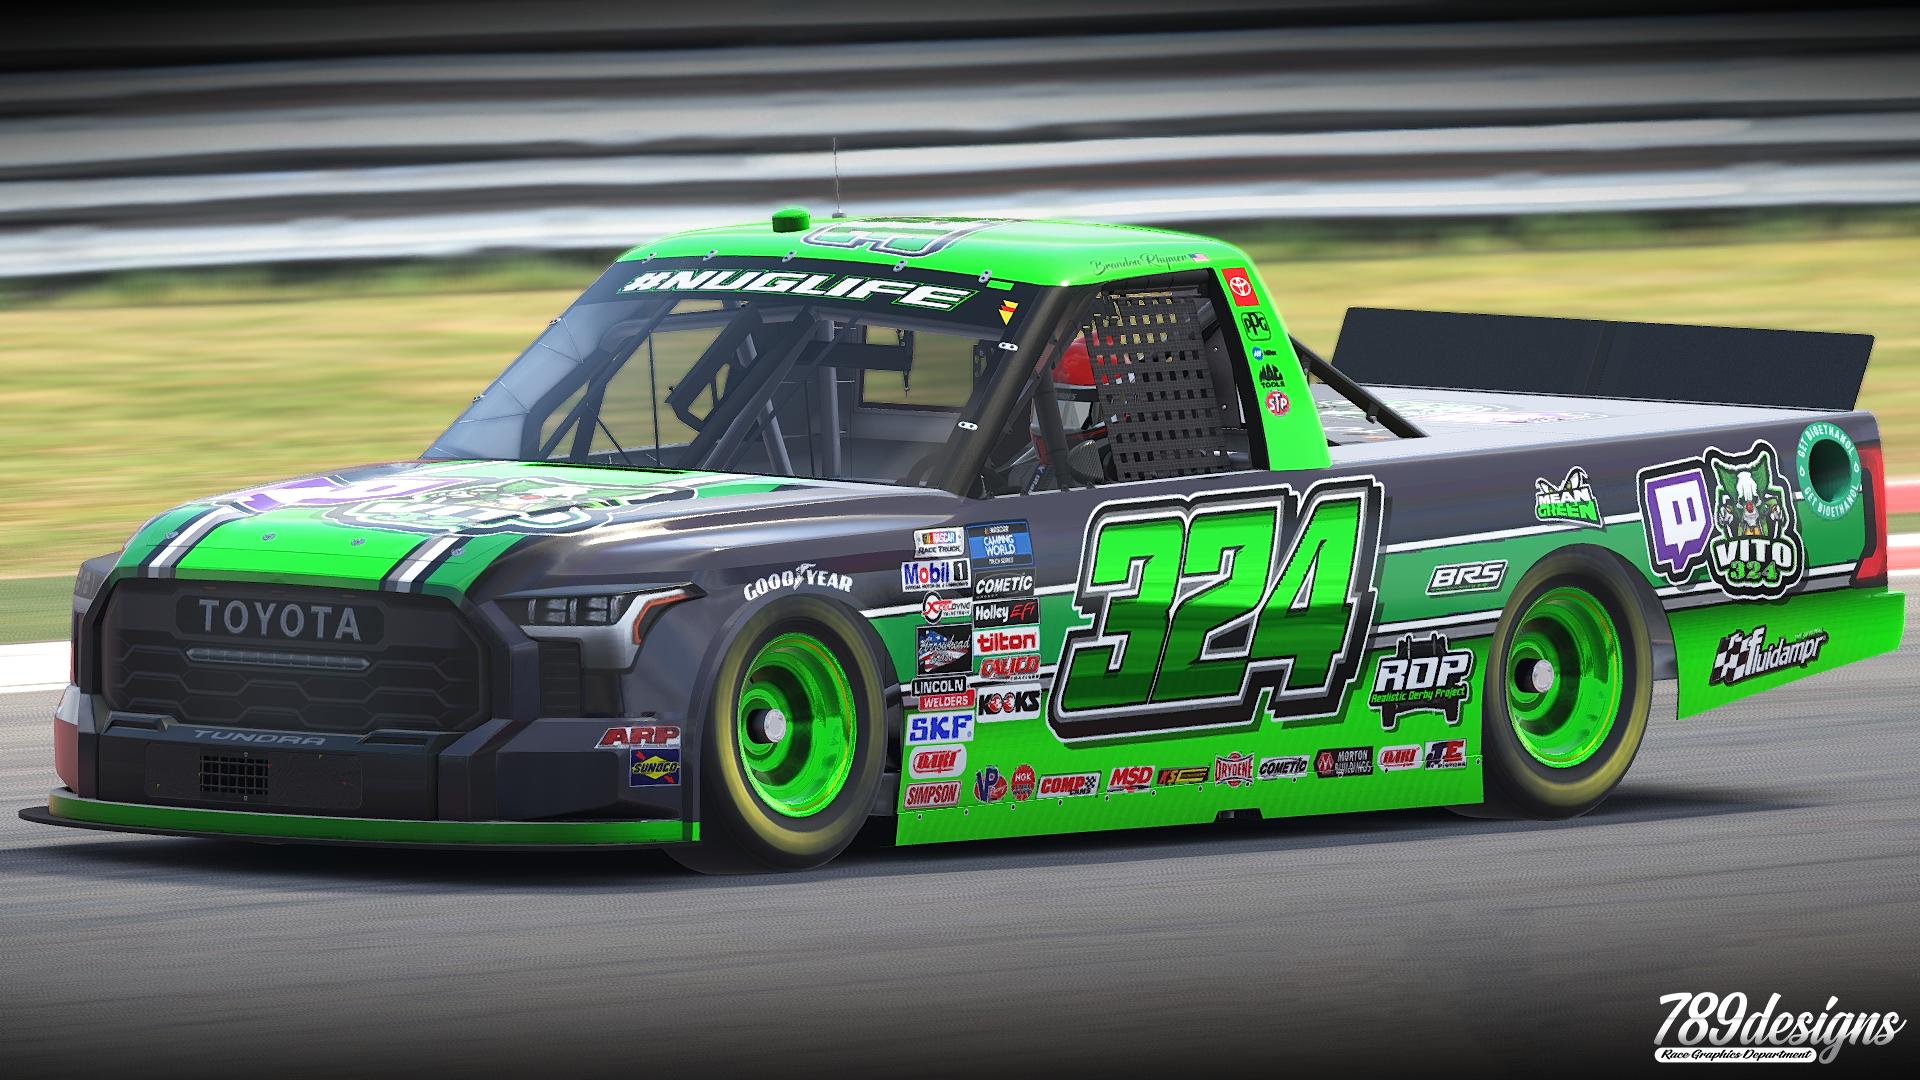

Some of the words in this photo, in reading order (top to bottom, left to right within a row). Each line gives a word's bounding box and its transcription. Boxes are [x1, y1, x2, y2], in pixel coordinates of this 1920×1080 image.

[621, 269, 974, 310] #NUGLIFE
[1268, 393, 1288, 413] STP
[1797, 437, 1809, 458] GET
[1804, 424, 1855, 456] BIOETHANOL
[1538, 487, 1591, 504] MEAN
[1804, 486, 1817, 506] GET
[1817, 482, 1860, 518] BIOETHANOL
[1537, 500, 1598, 521] GREEN
[985, 543, 1016, 557] WORLD
[1715, 539, 1794, 568] VITO
[904, 562, 950, 586] Mobil
[1432, 562, 1501, 588] BRS
[1730, 560, 1778, 580] 324
[975, 575, 1033, 595] COMETIC
[975, 603, 1010, 623] Holley
[1056, 490, 1369, 722] 324
[199, 599, 362, 641] TOYOTA
[976, 632, 1036, 653] tilton
[1375, 653, 1469, 692] RDP
[914, 679, 965, 695] LINCOLN
[1371, 691, 1407, 703] Realistic
[1408, 689, 1433, 702] Derby
[1434, 686, 1466, 699] Project
[923, 695, 969, 709] WELDERS
[978, 690, 1041, 716] KOOKS
[193, 729, 327, 746] TUNDRA
[600, 728, 680, 746] ARP
[909, 714, 973, 742] SKF
[1338, 750, 1368, 763] MORTON
[632, 761, 678, 774] SUNOCO
[1015, 772, 1032, 782] NGK
[1110, 766, 1154, 786] MSD
[1334, 760, 1373, 775] BUILDINGS
[1041, 776, 1086, 793] COMP
[907, 785, 957, 806] SIMPSON
